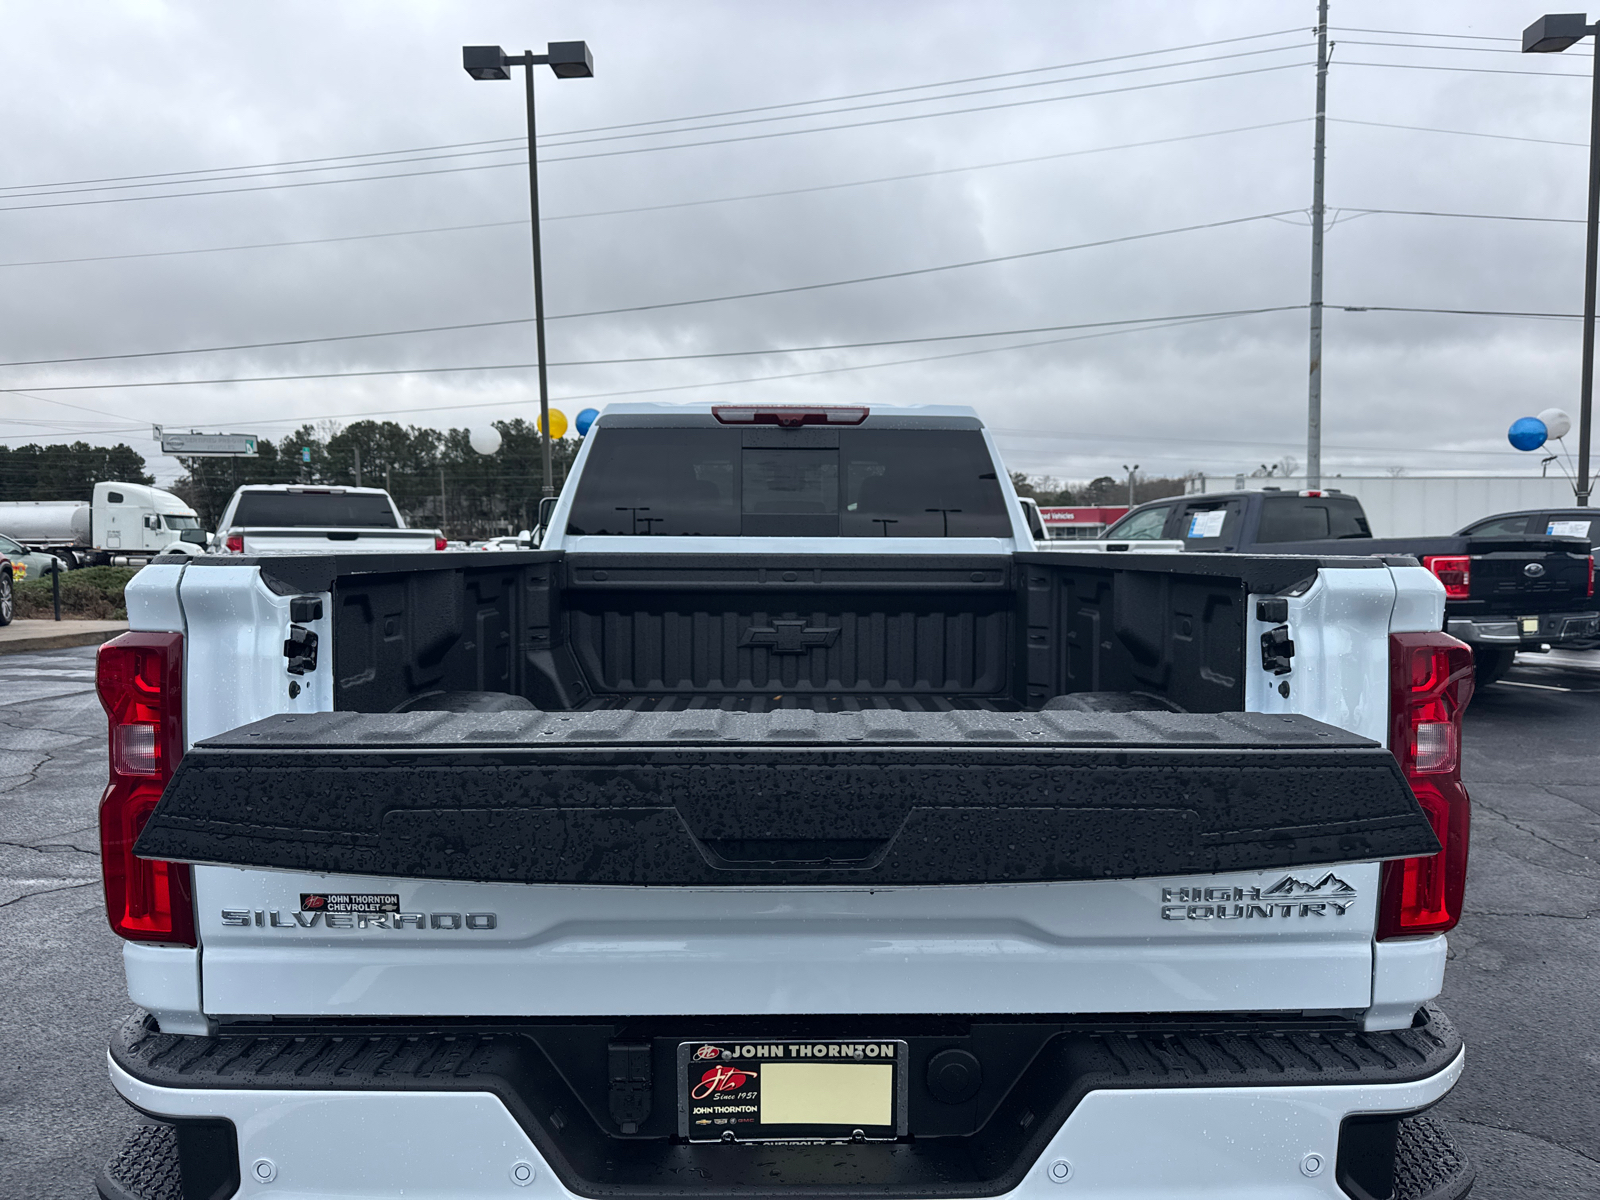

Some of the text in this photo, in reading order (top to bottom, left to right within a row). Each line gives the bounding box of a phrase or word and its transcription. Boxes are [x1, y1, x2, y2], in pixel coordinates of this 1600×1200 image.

[327, 895, 398, 904] JOHN THORNTON
[1161, 886, 1262, 902] HIGH
[327, 903, 381, 911] CHEVROLET
[1161, 901, 1355, 920] COUNTRY
[221, 908, 498, 930] SILVERADO
[732, 1044, 894, 1058] JOHN THORNTON
[713, 1091, 758, 1100] Since 1957
[692, 1105, 758, 1115] JOHN THORNTON
